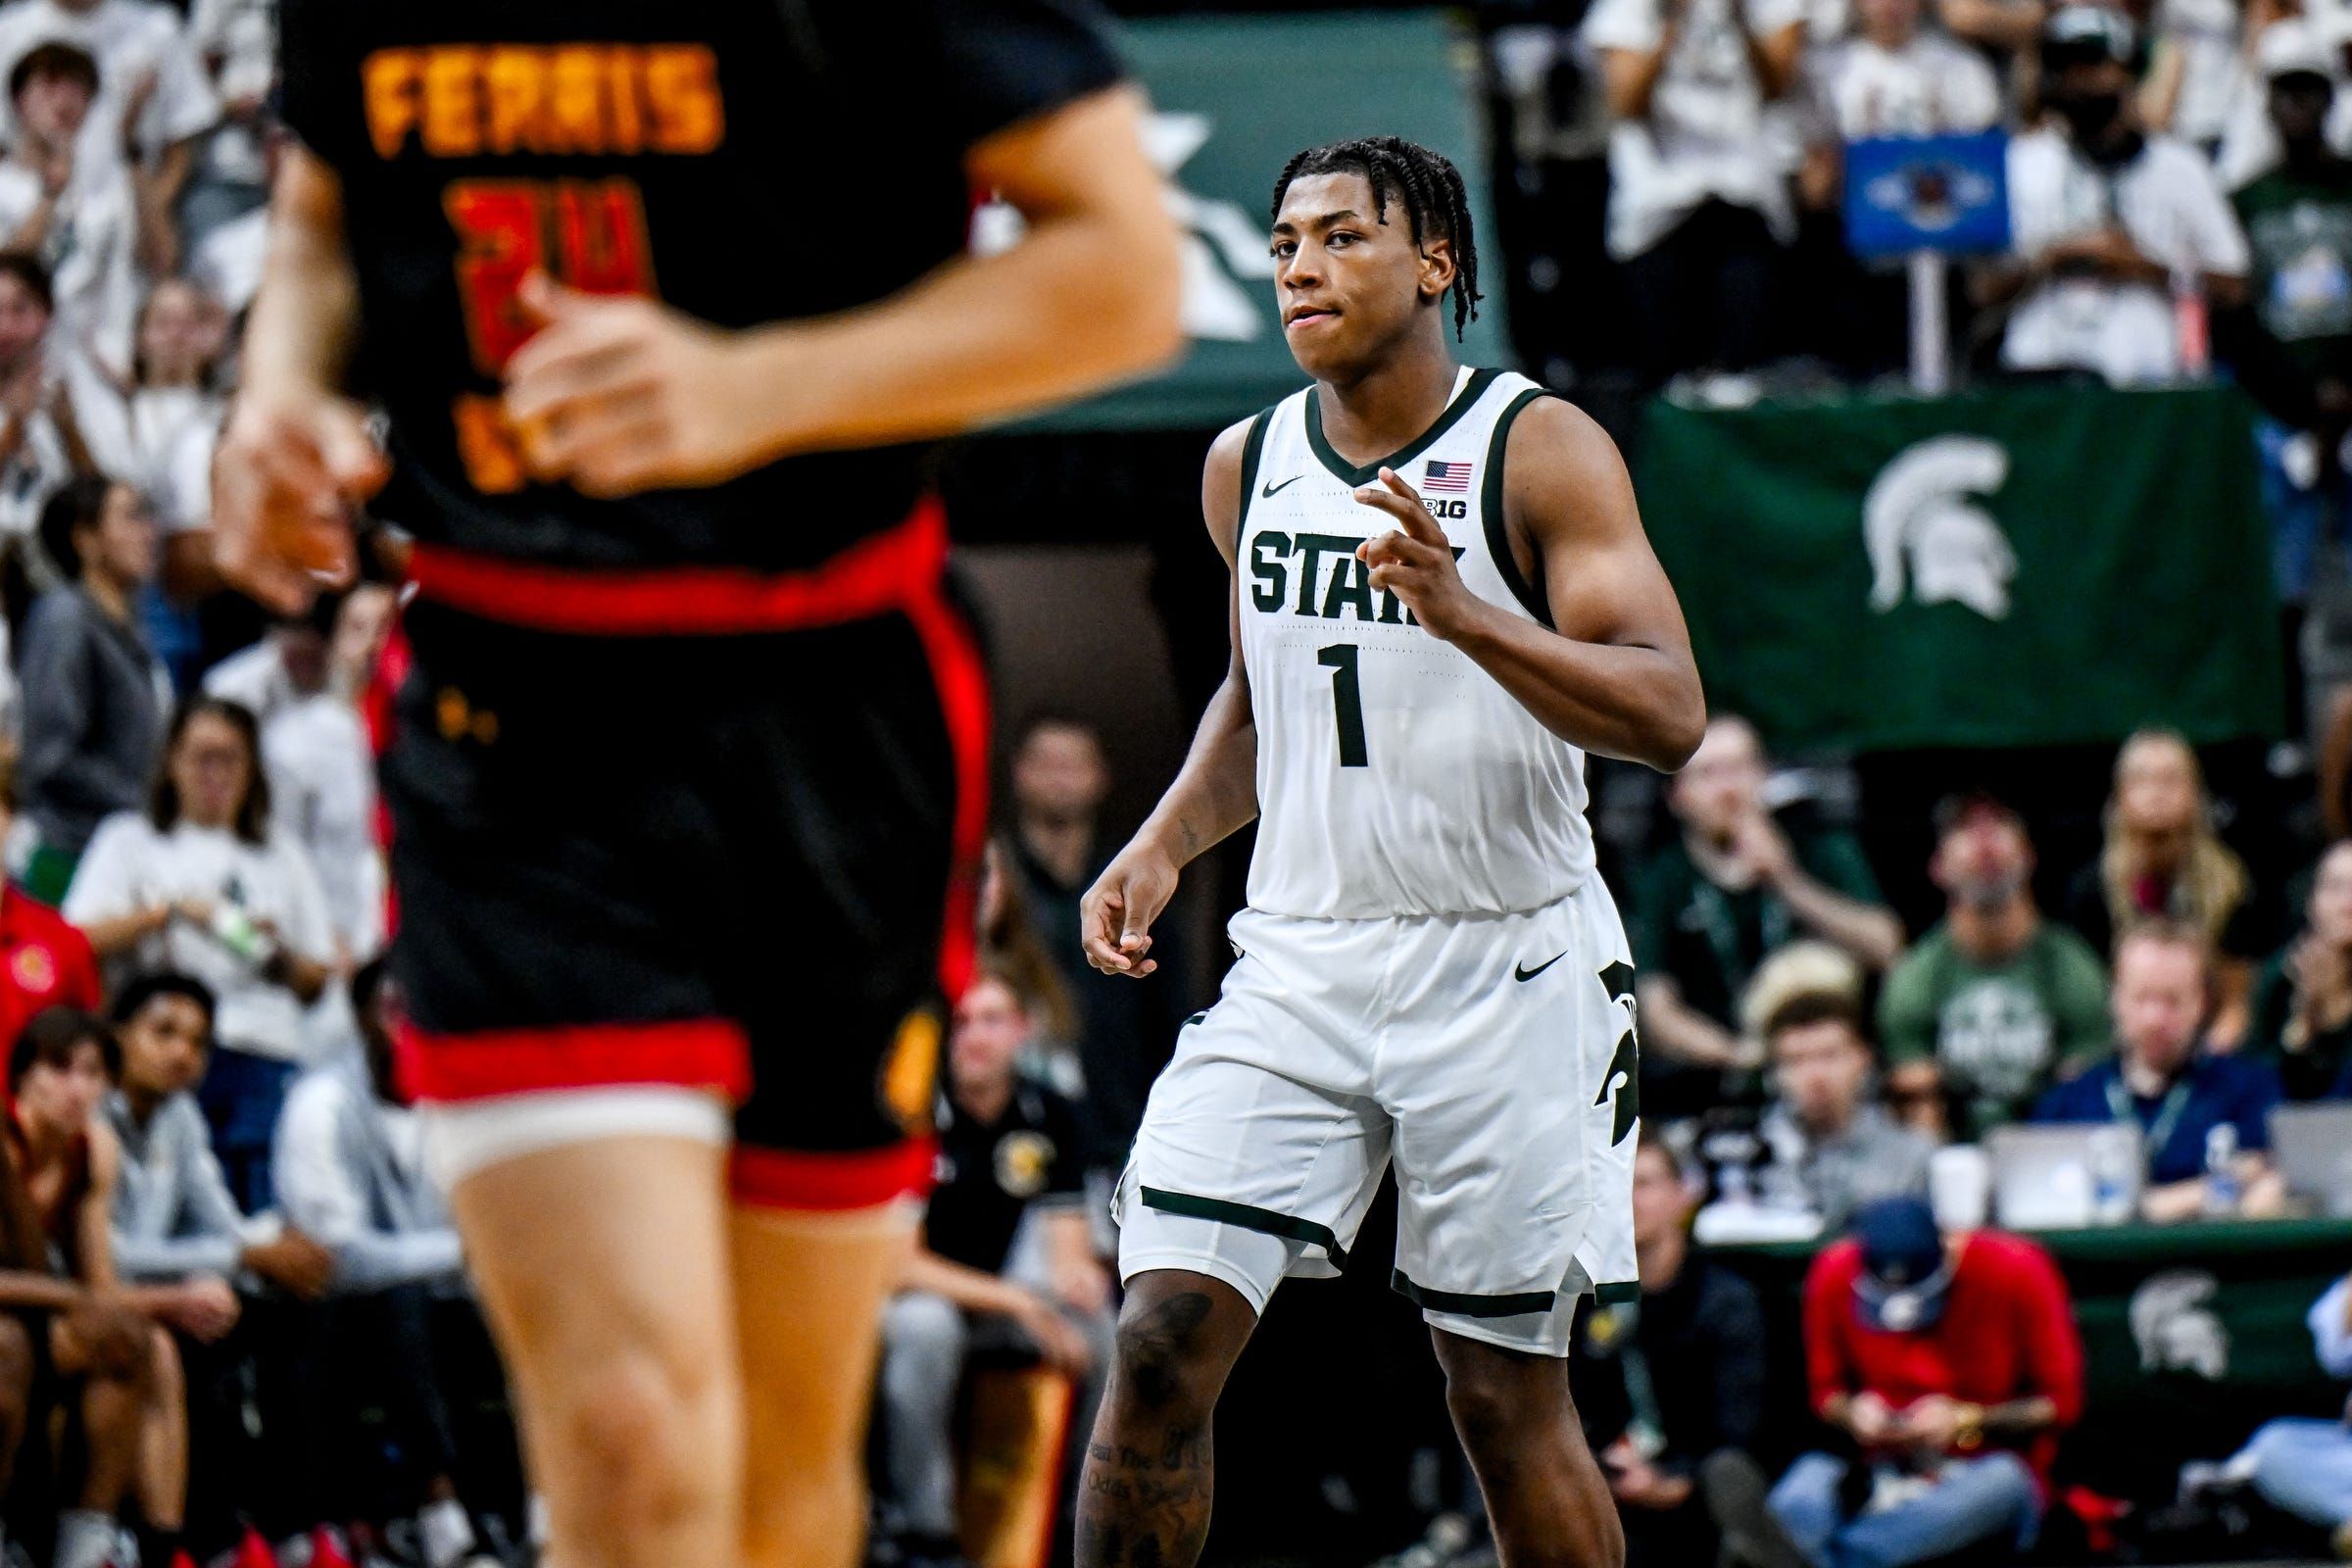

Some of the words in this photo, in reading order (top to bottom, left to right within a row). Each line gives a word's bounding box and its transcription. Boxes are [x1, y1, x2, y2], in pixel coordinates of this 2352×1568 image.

[363, 43, 724, 159] FERRIS
[1250, 530, 1466, 626] STA
[1317, 644, 1368, 767] 1
